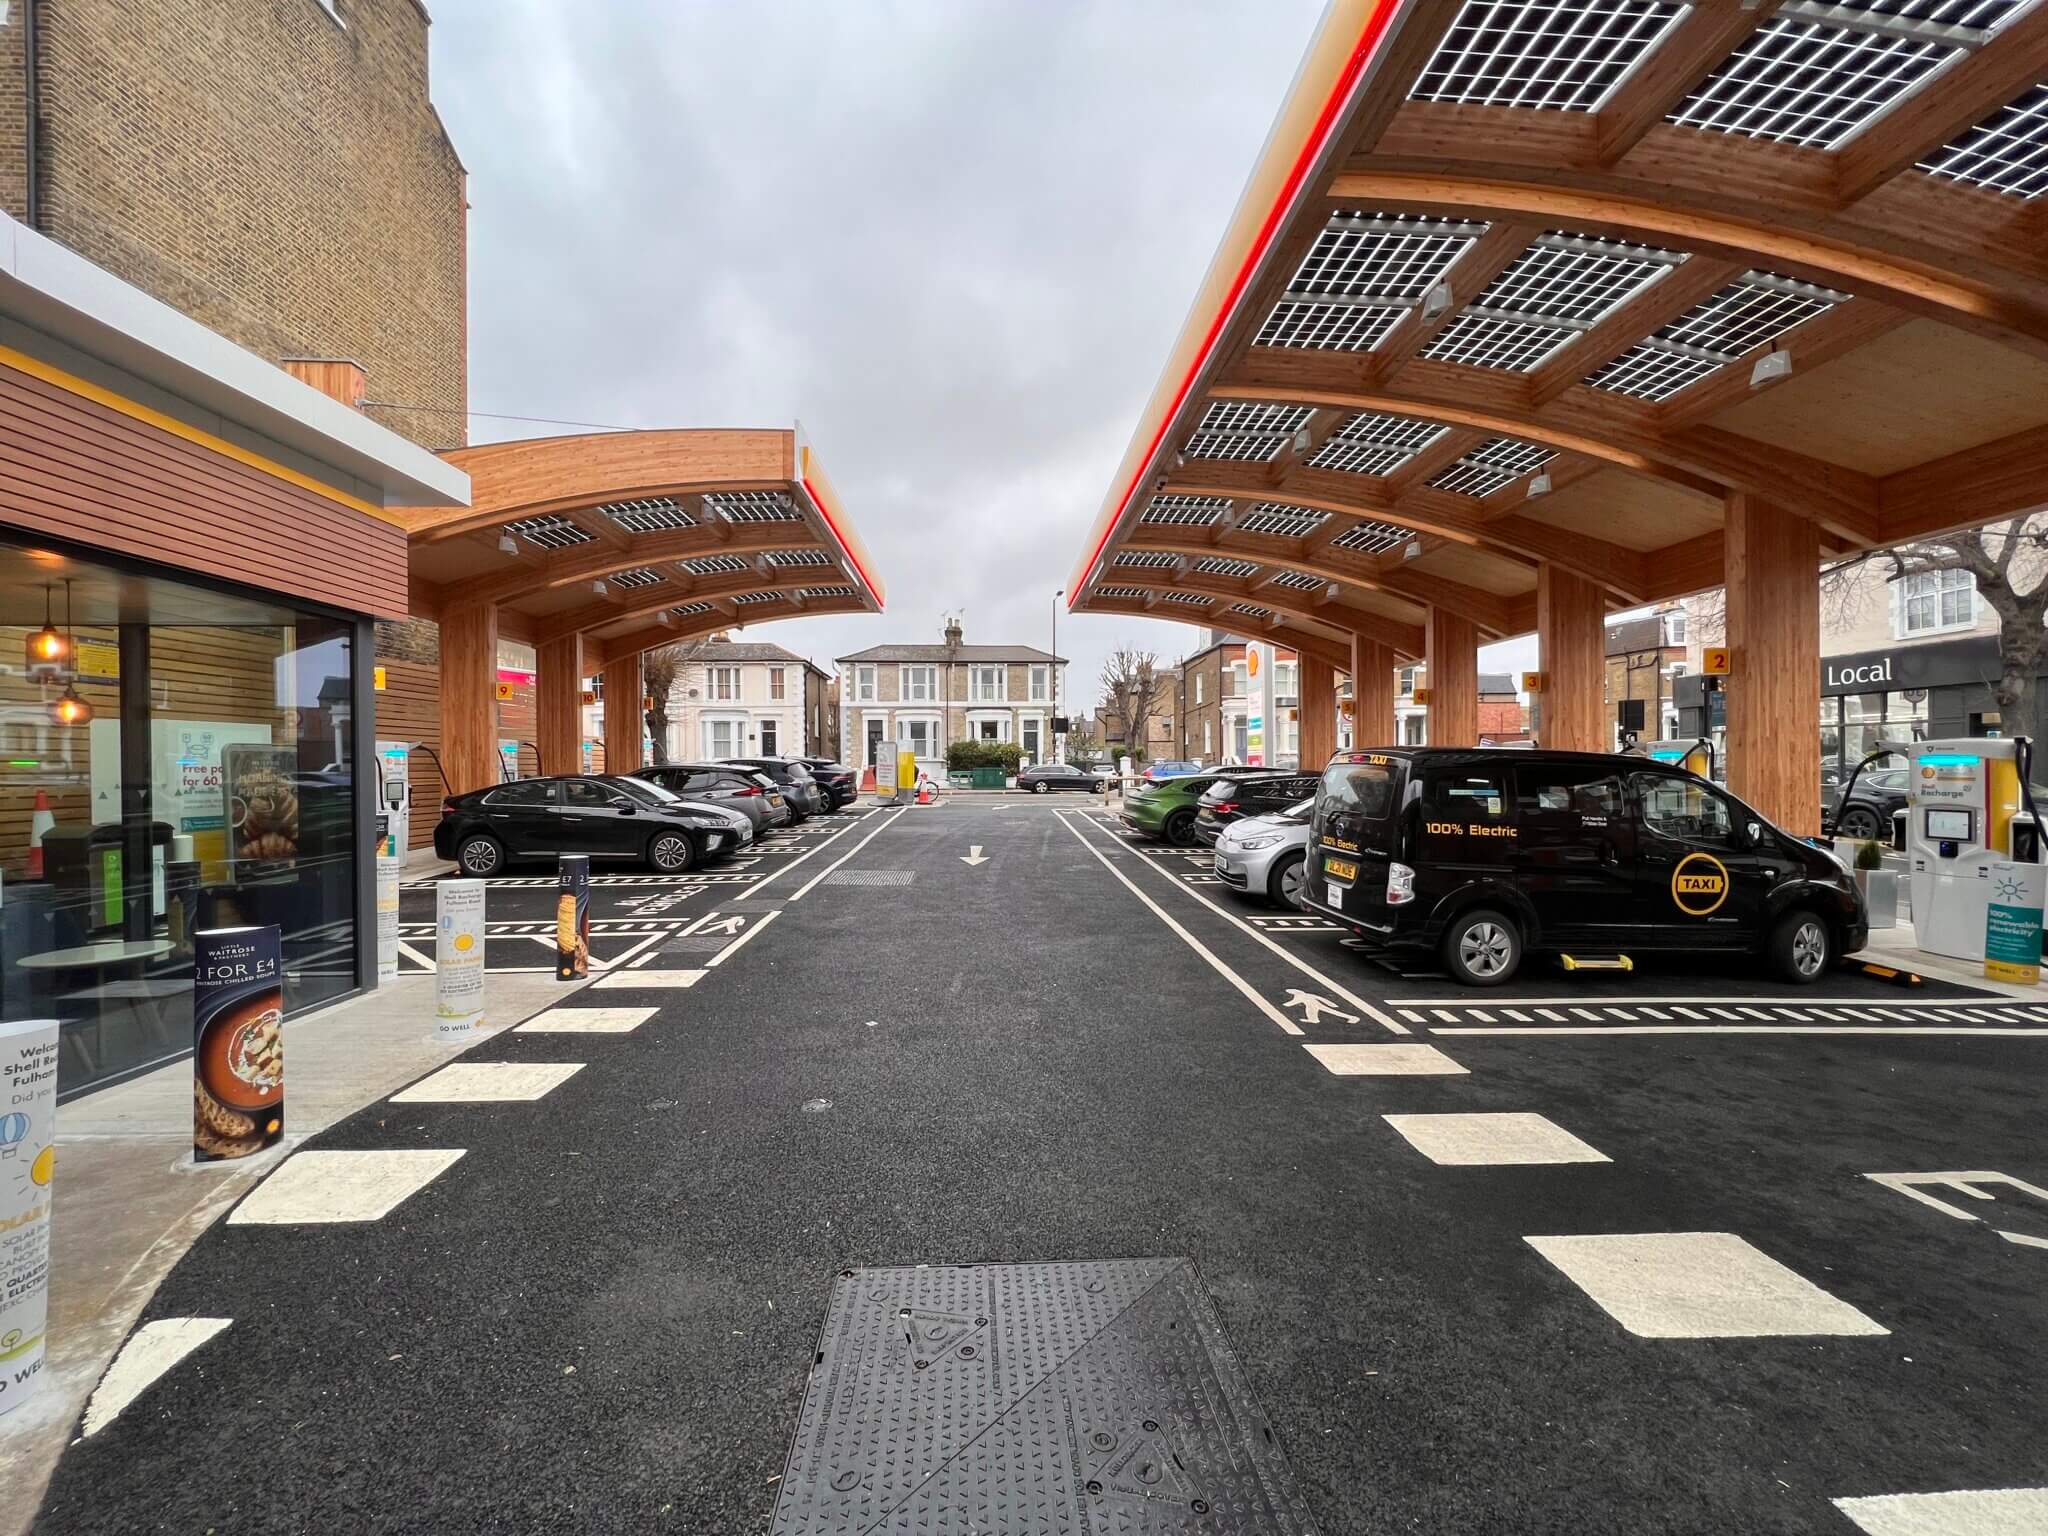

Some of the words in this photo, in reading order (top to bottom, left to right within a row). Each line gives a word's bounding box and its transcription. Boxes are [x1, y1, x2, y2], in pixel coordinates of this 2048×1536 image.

[1714, 655, 1724, 668] 2
[1828, 658, 1892, 686] Local
[1528, 676, 1537, 687] 3
[500, 686, 507, 695] 9
[583, 694, 593, 702] 10
[1370, 755, 1387, 765] TAXI
[182, 765, 208, 773] Free
[183, 776, 199, 786] for
[203, 776, 218, 786] 60
[1921, 789, 1964, 798] Recharge
[1426, 823, 1463, 835] 100%
[1469, 824, 1518, 837] Electric
[1323, 836, 1336, 847] 100%
[1337, 840, 1358, 851] Electric
[1683, 879, 1715, 889] TAXI
[208, 946, 256, 957] WAITROSE
[207, 964, 248, 979] FOR
[256, 957, 275, 973] £4
[224, 976, 255, 985] CHILLED
[451, 1023, 470, 1032] WELL
[4, 1058, 40, 1075] Shell
[12, 1091, 33, 1104] Did
